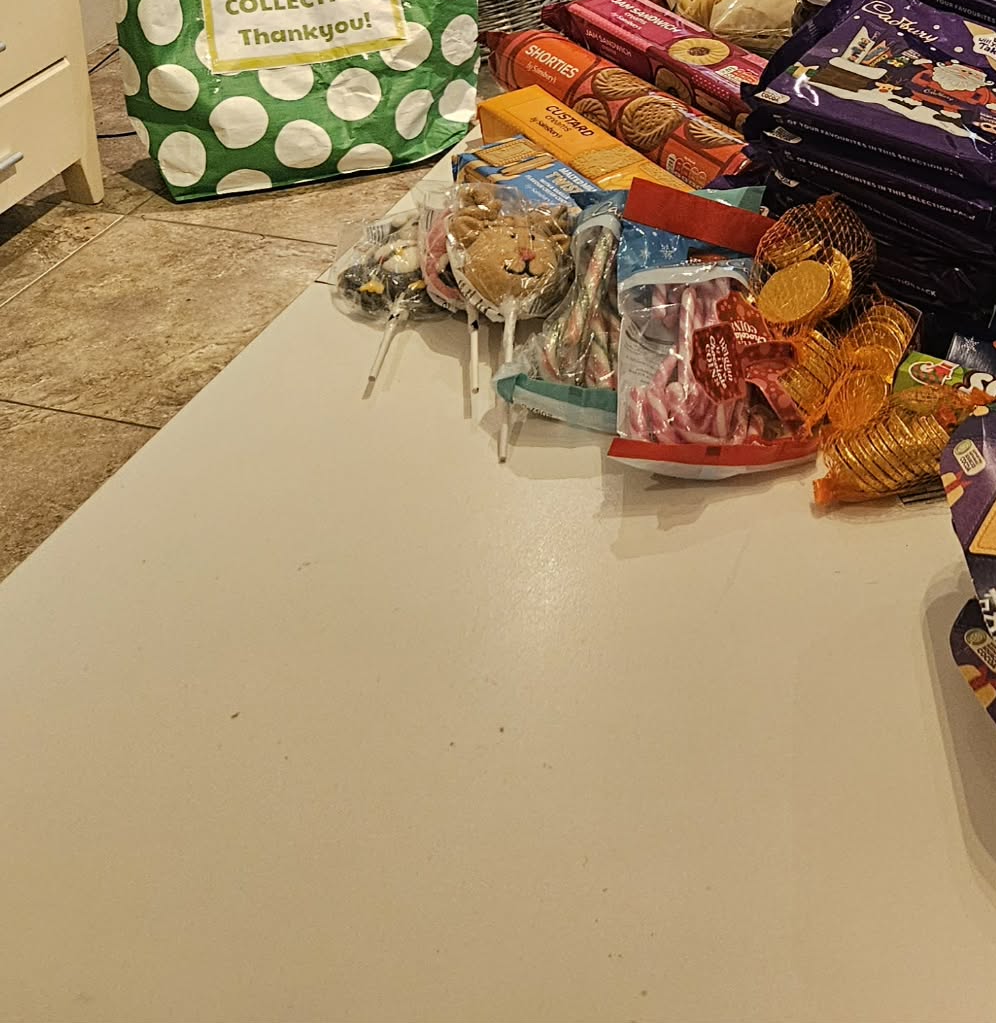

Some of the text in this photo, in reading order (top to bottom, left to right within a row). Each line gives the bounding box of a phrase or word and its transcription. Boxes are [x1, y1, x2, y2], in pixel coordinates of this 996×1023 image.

[238, 12, 372, 46] Thankyou!
[611, 0, 682, 33] JAM SANDWICH
[862, 0, 938, 42] Cadbury
[525, 45, 579, 78] SHORTIES
[546, 106, 594, 136] CUSTARD
